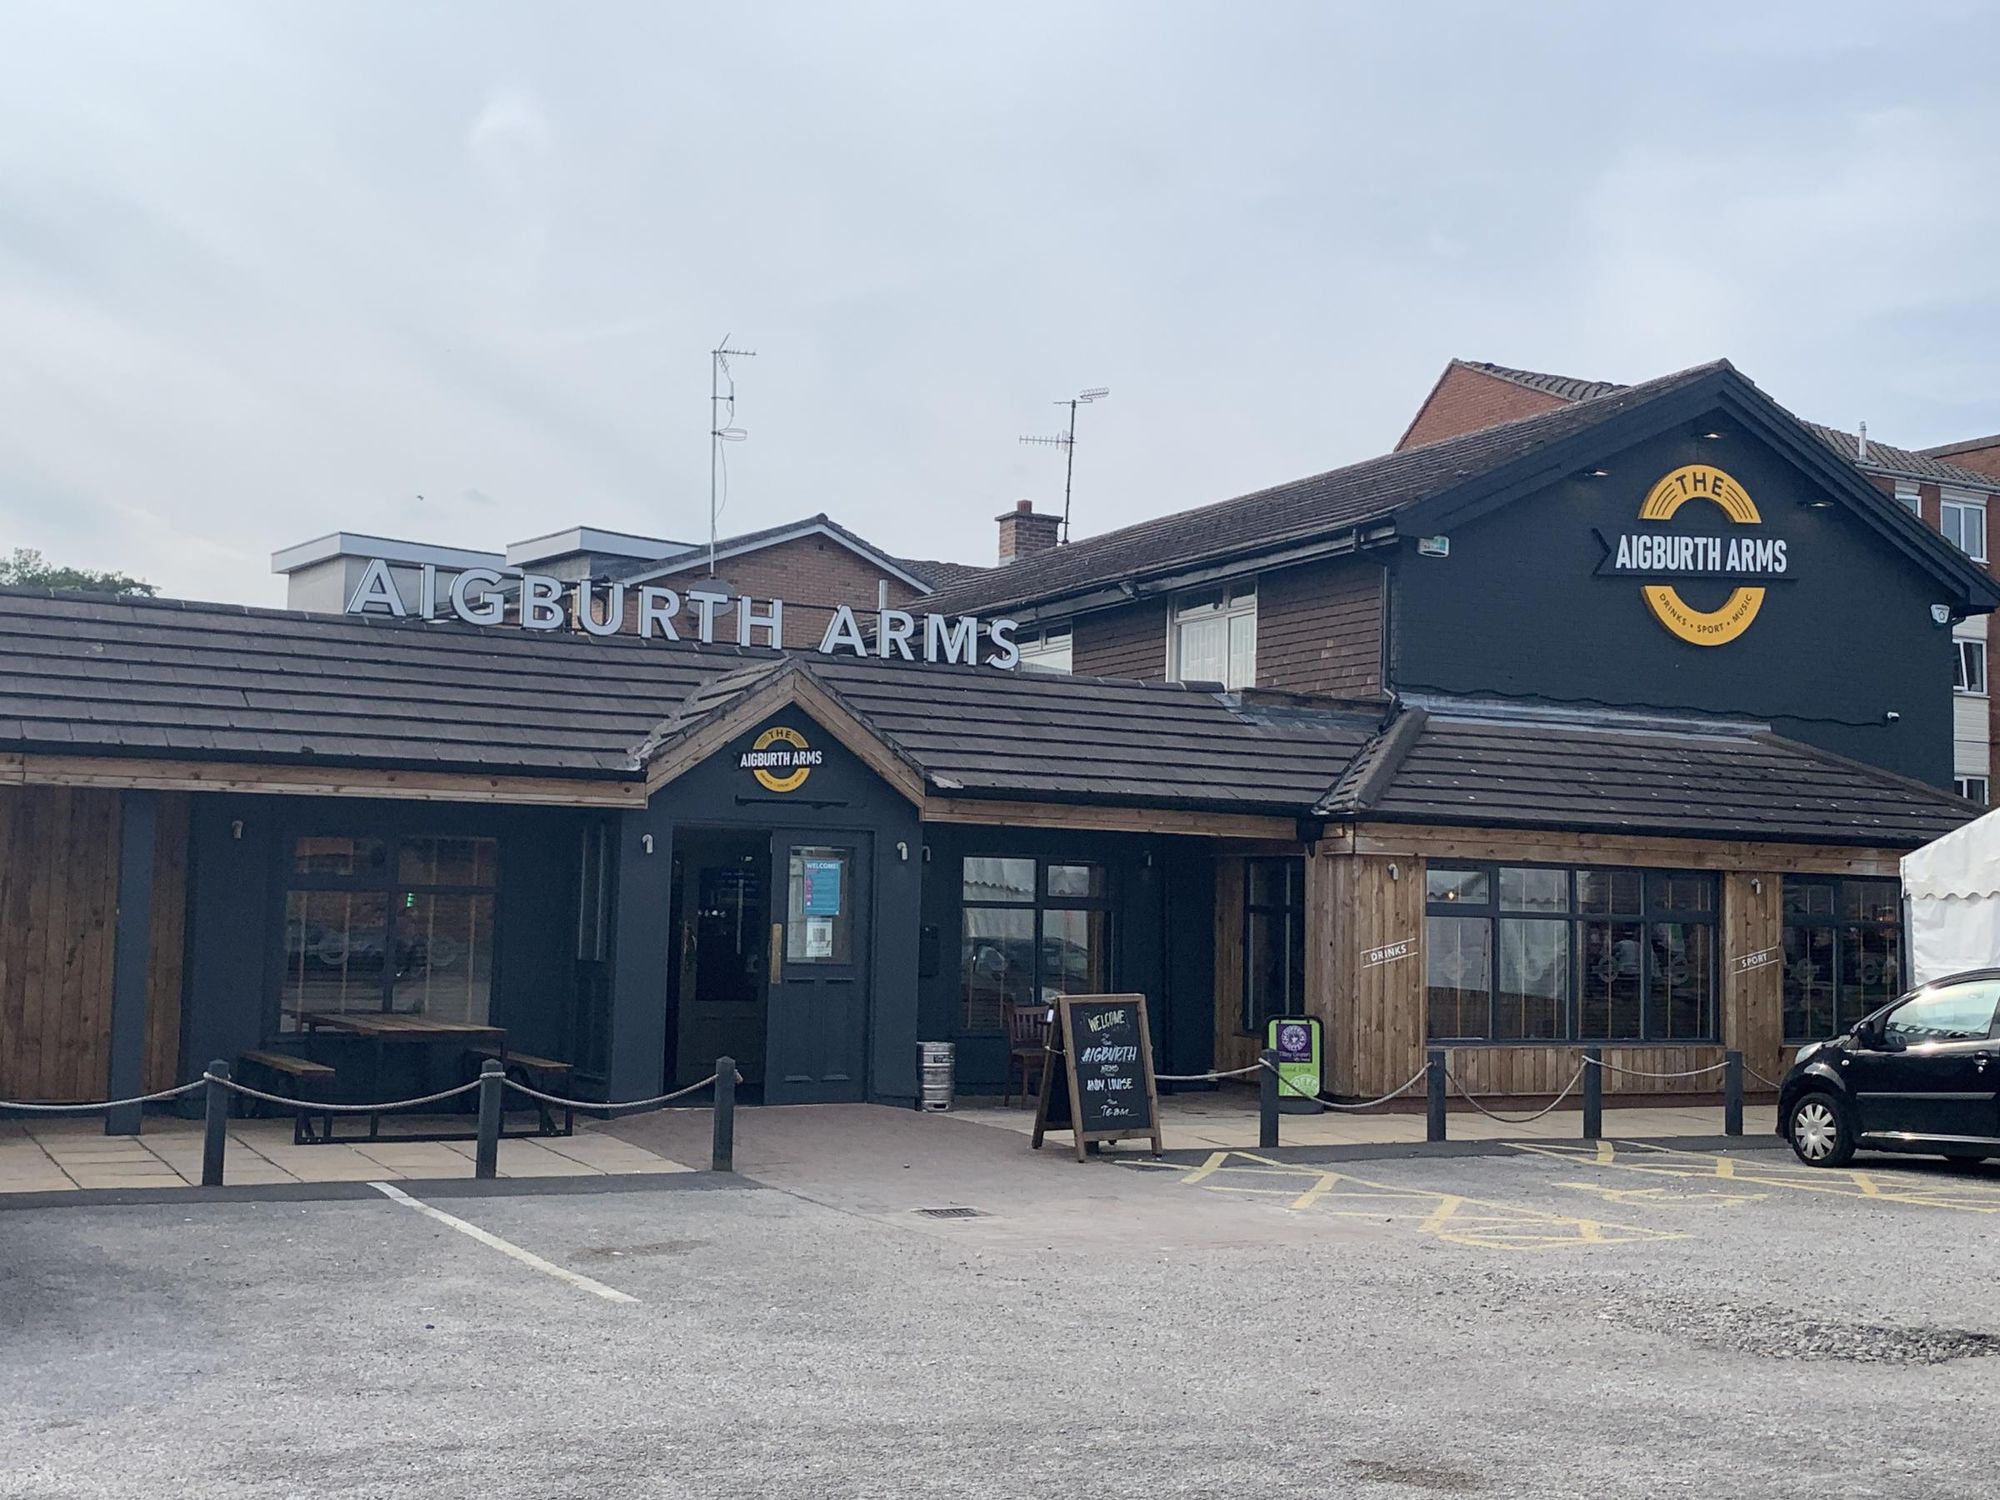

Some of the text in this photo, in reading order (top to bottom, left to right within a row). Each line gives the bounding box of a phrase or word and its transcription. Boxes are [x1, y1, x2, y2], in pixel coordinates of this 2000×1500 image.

[1675, 472, 1724, 497] THE
[1615, 534, 1788, 573] AIGBURTH ARMS
[346, 558, 1022, 671] AIGBURTH ARMS
[1658, 593, 1753, 634] DRINKS SPORT MUSIC
[768, 729, 792, 739] THE
[740, 751, 823, 767] AIGBURTH ARMS
[1370, 945, 1407, 961] DRINKS
[1741, 953, 1767, 968] SPORT
[1088, 1010, 1125, 1032] WELCOME
[1081, 1046, 1137, 1062] AIGBURTH
